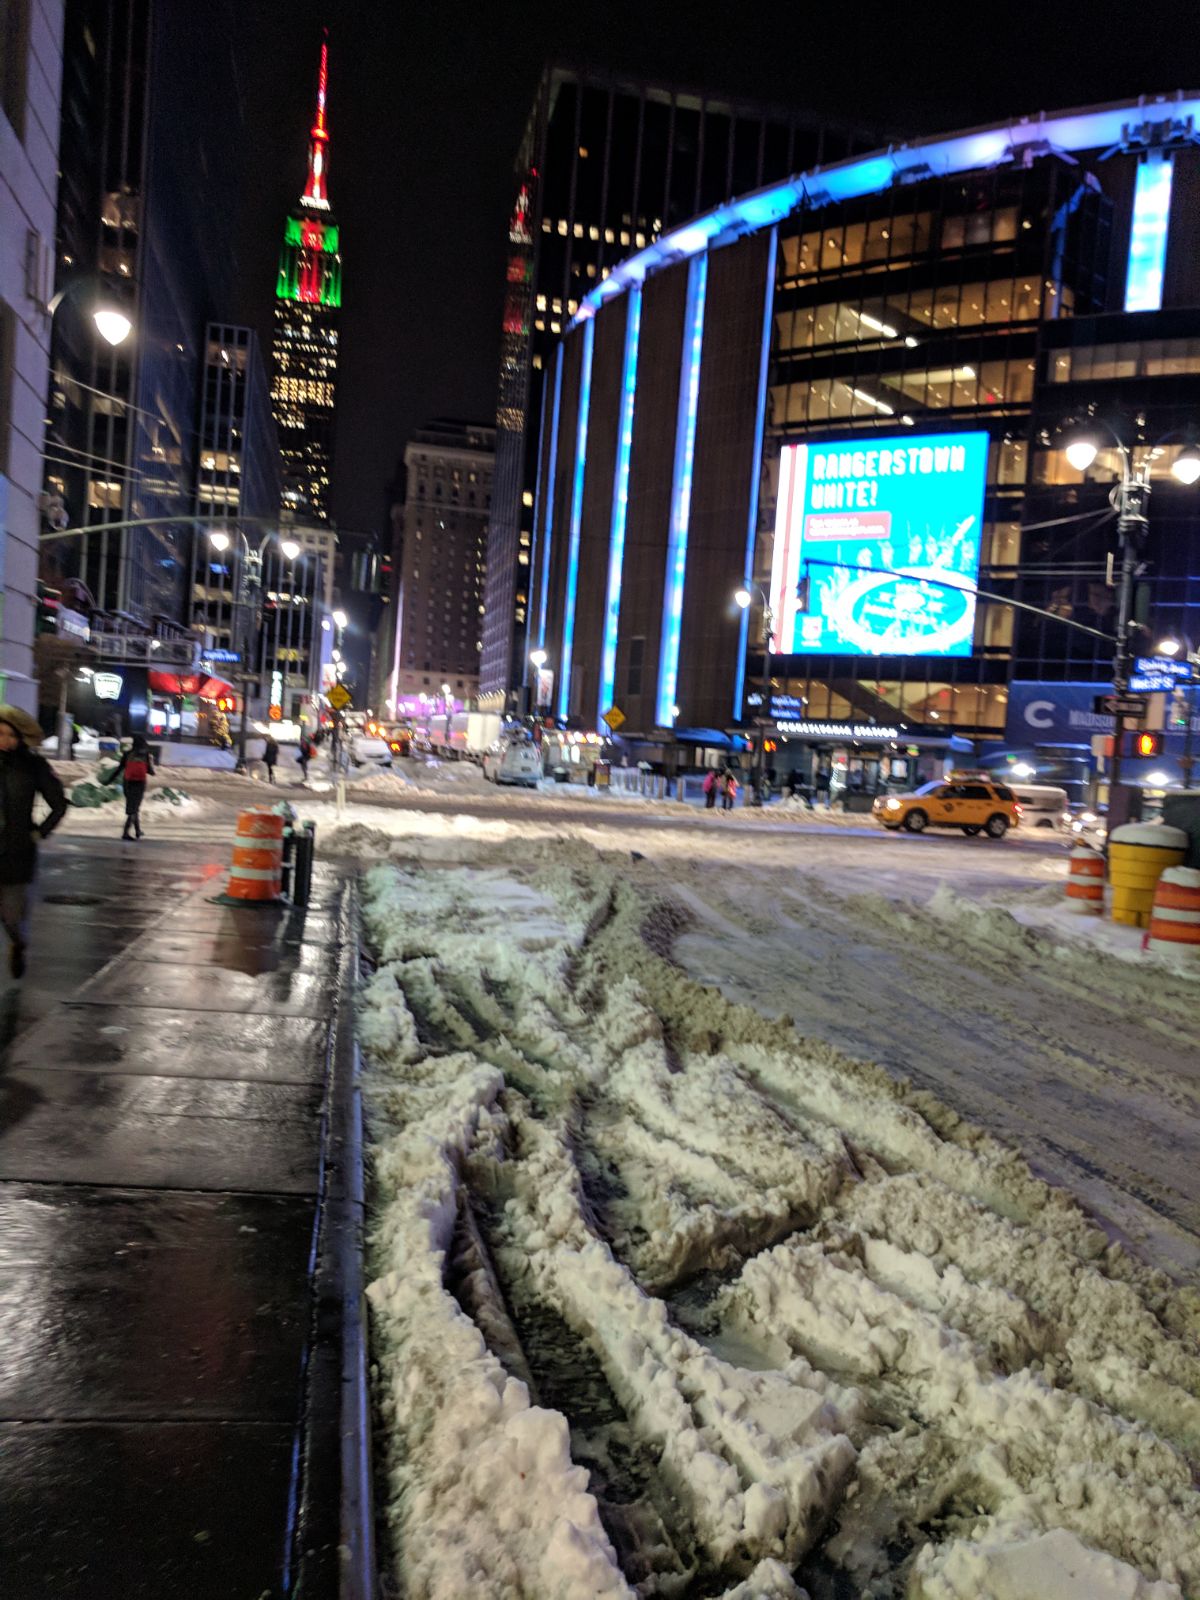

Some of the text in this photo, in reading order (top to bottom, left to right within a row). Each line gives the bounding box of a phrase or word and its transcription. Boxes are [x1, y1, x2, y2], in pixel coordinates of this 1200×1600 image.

[813, 445, 966, 480] RANGERSTOWN
[811, 480, 878, 509] UNITE!
[777, 721, 898, 738] PENNSYLVANIA STATION
